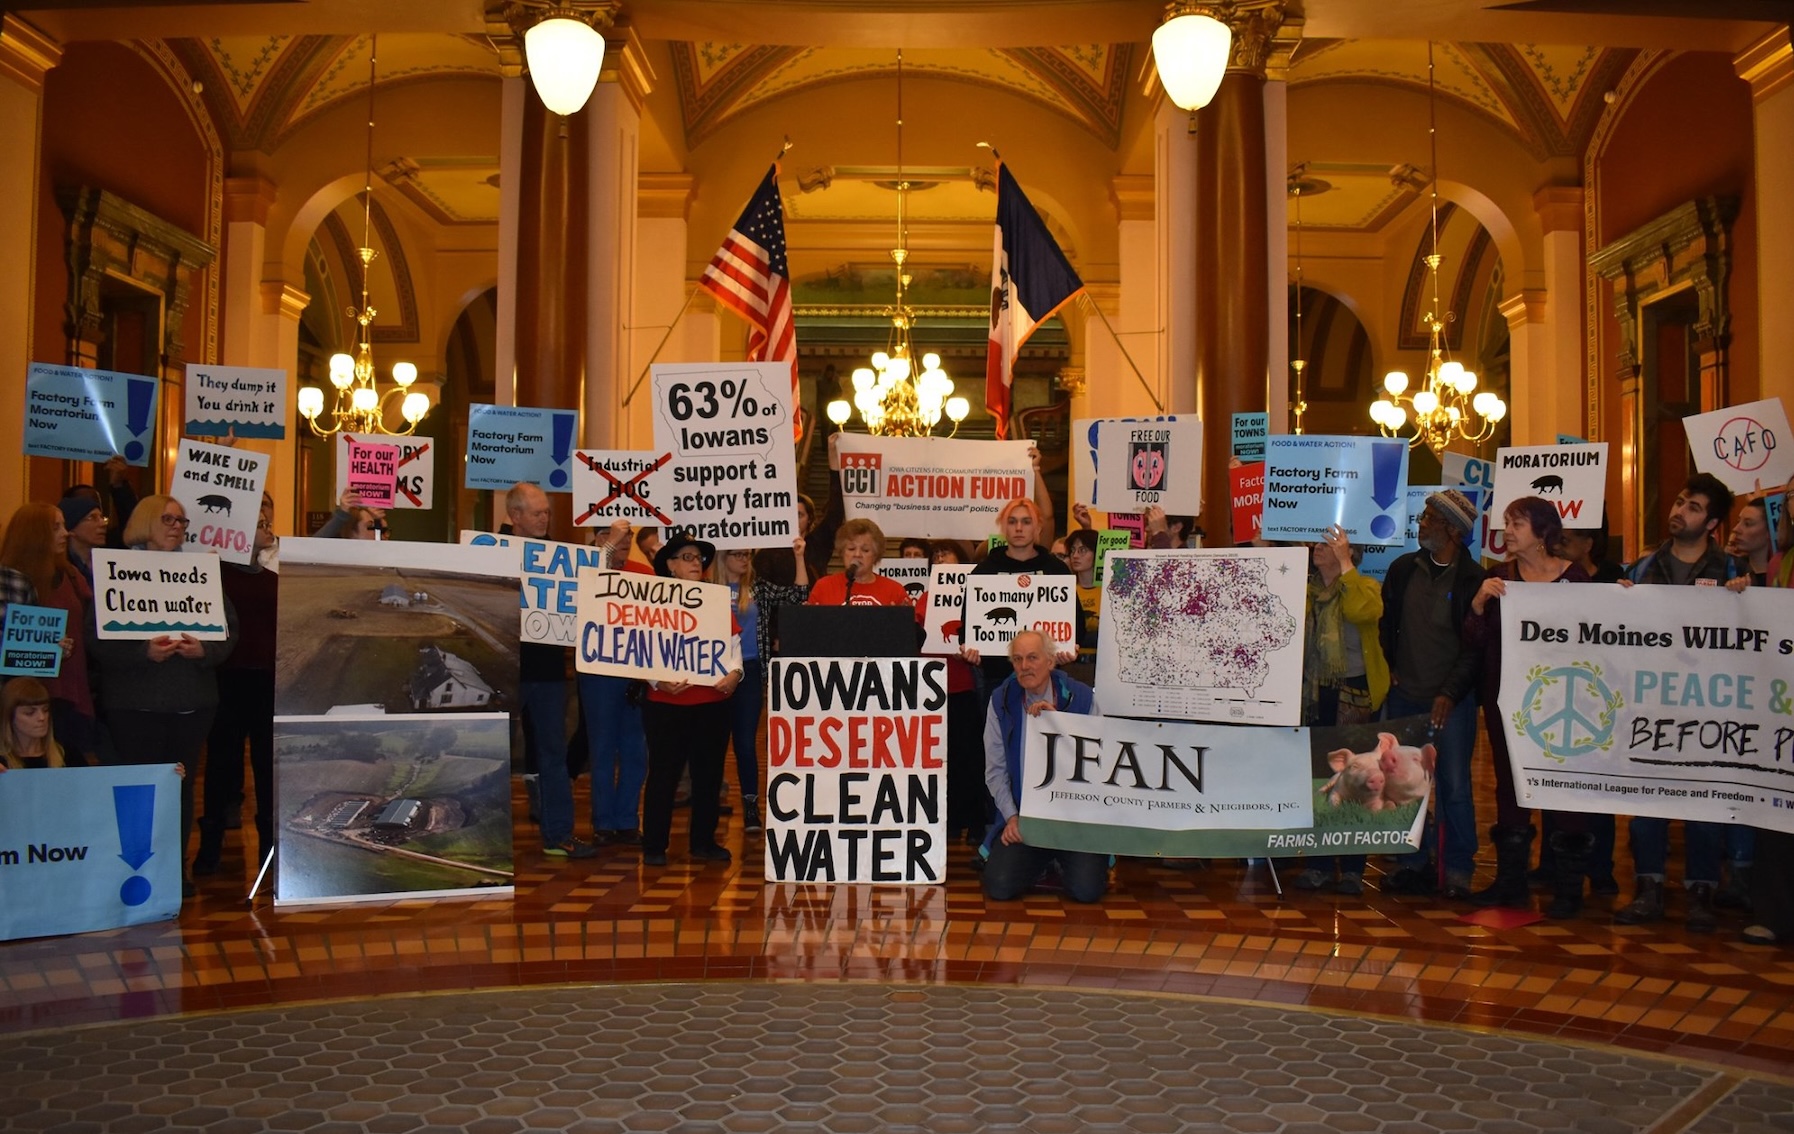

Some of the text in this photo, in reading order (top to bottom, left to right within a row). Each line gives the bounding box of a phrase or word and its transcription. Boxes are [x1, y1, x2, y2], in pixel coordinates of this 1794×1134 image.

[60, 369, 82, 378] WATER
[83, 373, 113, 382] CTION!
[196, 373, 276, 396] They dump it
[31, 391, 115, 409] Factory Fam
[197, 395, 275, 413] You drink it
[668, 379, 777, 421] 63% of
[29, 418, 58, 430] Now
[1235, 418, 1265, 427] For our
[472, 429, 543, 443] Factory Farm
[681, 427, 769, 450] Iowans
[1131, 430, 1171, 442] FREE OUR
[1234, 428, 1266, 438] TOWNS
[471, 442, 534, 454] Moratorium
[1324, 441, 1356, 449] ACTION!
[1713, 428, 1777, 460] CAFO
[189, 448, 258, 472] WAKE UP
[353, 447, 372, 460] For
[375, 450, 394, 461] our
[471, 455, 496, 464] Now
[1503, 452, 1599, 469] MORATORIUM
[351, 461, 394, 475] HEALTH
[588, 456, 659, 472] Industrial
[673, 460, 777, 486] support a
[183, 470, 255, 491] and SMELL
[844, 468, 876, 494] CCI
[1269, 466, 1359, 481] Factory Farm
[608, 480, 650, 498] HOG
[886, 474, 1026, 500] ACTION FUND
[1240, 477, 1265, 489] Facto
[1269, 482, 1346, 494] Moratorium
[673, 488, 791, 515] actory farm
[1135, 491, 1160, 503] FOOD
[1268, 498, 1298, 509] Now
[588, 503, 661, 517] Factories
[855, 502, 891, 511] Changing
[893, 503, 930, 512] "business
[970, 505, 999, 513] politics
[665, 517, 790, 540] moratorium
[1098, 535, 1128, 547] For good
[107, 561, 208, 585] Iowa needs
[595, 572, 703, 609] Iowans
[974, 587, 996, 603] Too
[999, 590, 1034, 609] many
[1037, 586, 1069, 603] PIGS
[106, 588, 212, 614] Clean water
[934, 594, 963, 607] ENO
[11, 610, 61, 628] For our
[607, 602, 698, 634] DEMAND
[7, 628, 61, 644] FUTURE
[972, 625, 995, 642] Too
[1520, 620, 1569, 644] Des
[1578, 622, 1673, 648] Moines
[1683, 626, 1769, 652] WILPF
[8, 652, 54, 660] moratorium
[582, 621, 729, 677] CLEAN WATER
[15, 660, 46, 668] NOW!
[771, 661, 947, 711] IOWANS
[1634, 670, 1793, 716] PEACE &
[769, 715, 943, 769] DESERVE
[1629, 717, 1760, 756] BEFORE
[1033, 731, 1211, 794] JFAN
[768, 772, 939, 824] CLEAN
[1541, 778, 1602, 791] International
[1605, 783, 1639, 795] League
[1641, 785, 1655, 795] for
[1658, 786, 1688, 797] Peace
[1690, 789, 1709, 798] and
[1711, 790, 1754, 803] Freedom
[1194, 803, 1206, 814] &
[1267, 830, 1410, 849] FARMS, NOT FACTOR
[28, 843, 88, 863] Now
[766, 828, 937, 882] WATER
